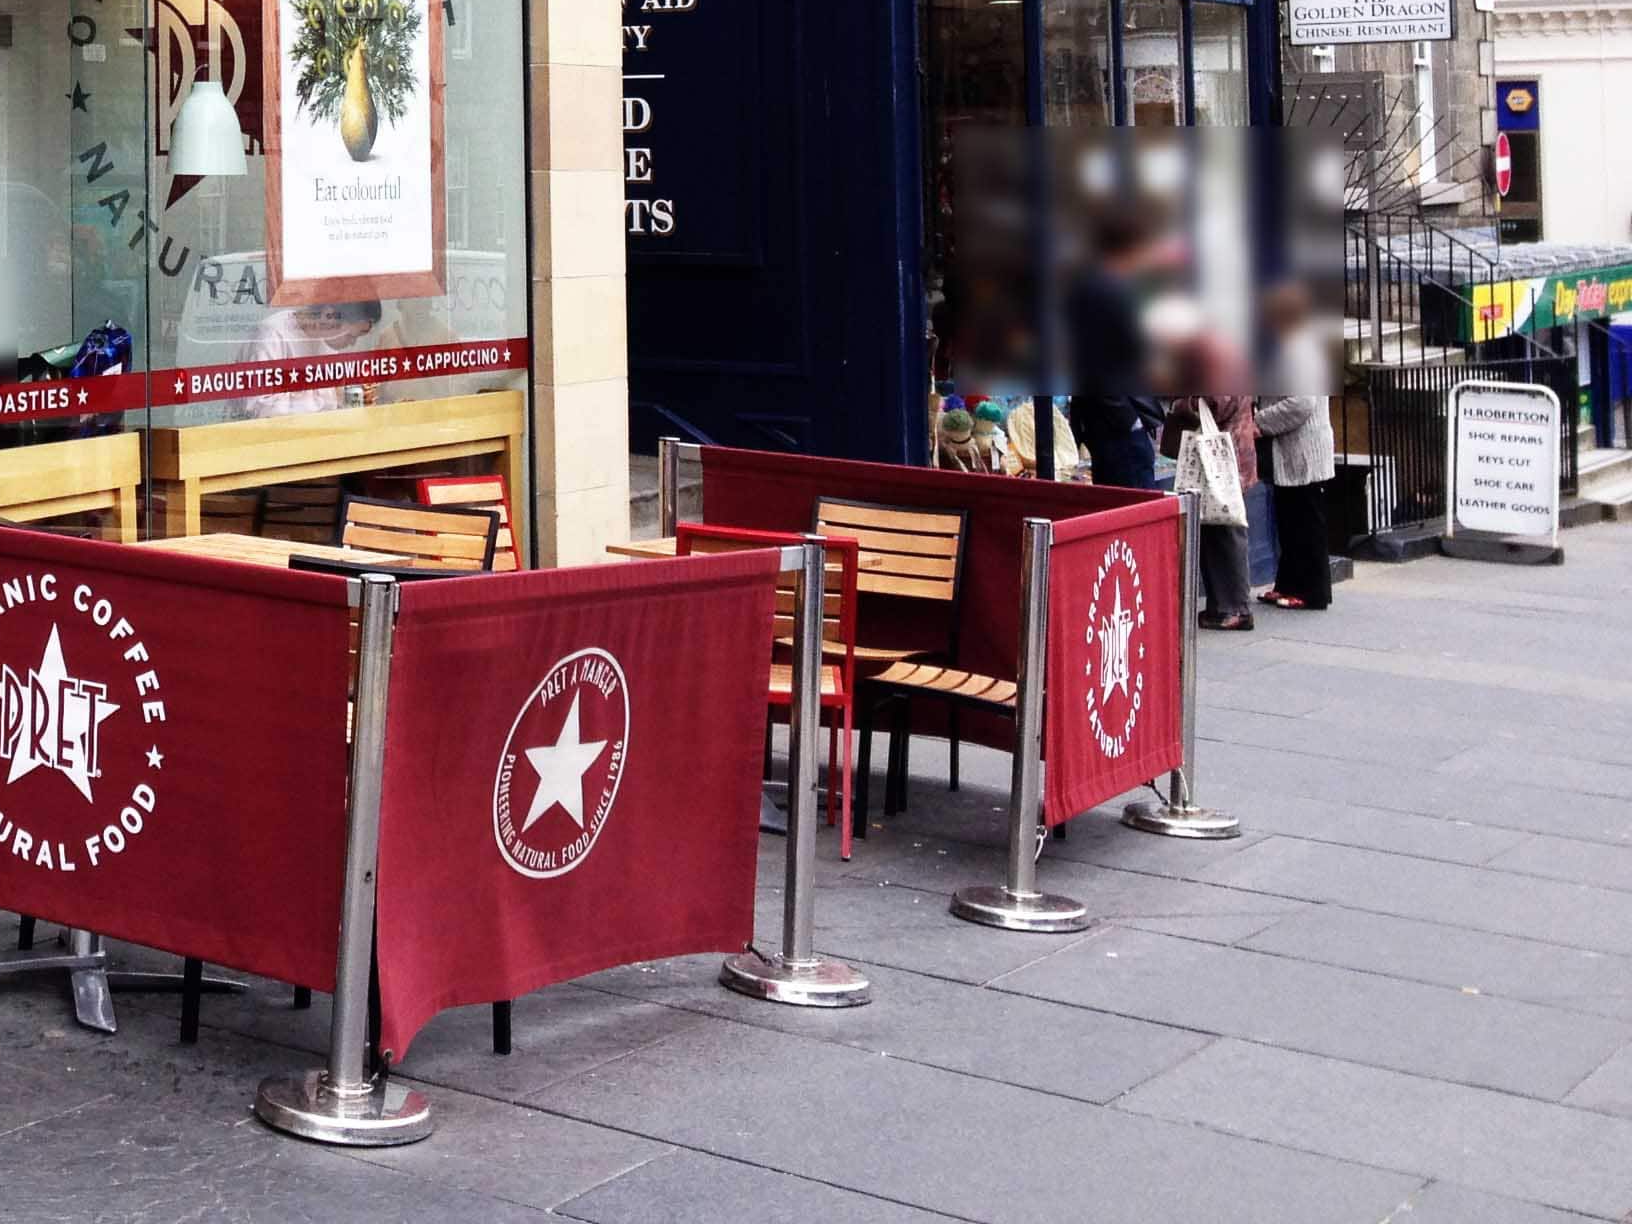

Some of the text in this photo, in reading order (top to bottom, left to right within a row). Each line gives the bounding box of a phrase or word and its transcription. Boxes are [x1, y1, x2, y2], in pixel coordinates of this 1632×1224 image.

[1294, 2, 1446, 21] GOLDEN DRAGON
[1295, 23, 1447, 39] CHINESE RESTAURANT
[313, 174, 401, 202] Eat colourful
[191, 347, 499, 395] BAGUETTES SANDWICHES CAPPUCCINO
[1468, 431, 1543, 445] SHOE REPAIRS
[1478, 455, 1531, 467] KEYS CUT
[1460, 497, 1550, 514] LEATHER GOODS
[1474, 478, 1535, 491] SHOE CARE
[1085, 539, 1119, 644] ORGANIC
[73, 584, 166, 723] COFFEE
[540, 657, 619, 708] PRET A MANGER
[0, 663, 107, 778] PRET
[1086, 672, 1143, 759] NATURAL FOOD
[85, 783, 156, 866] FOOD
[498, 740, 624, 871] PIONEERING NATURAL FOOD SINCE 1986
